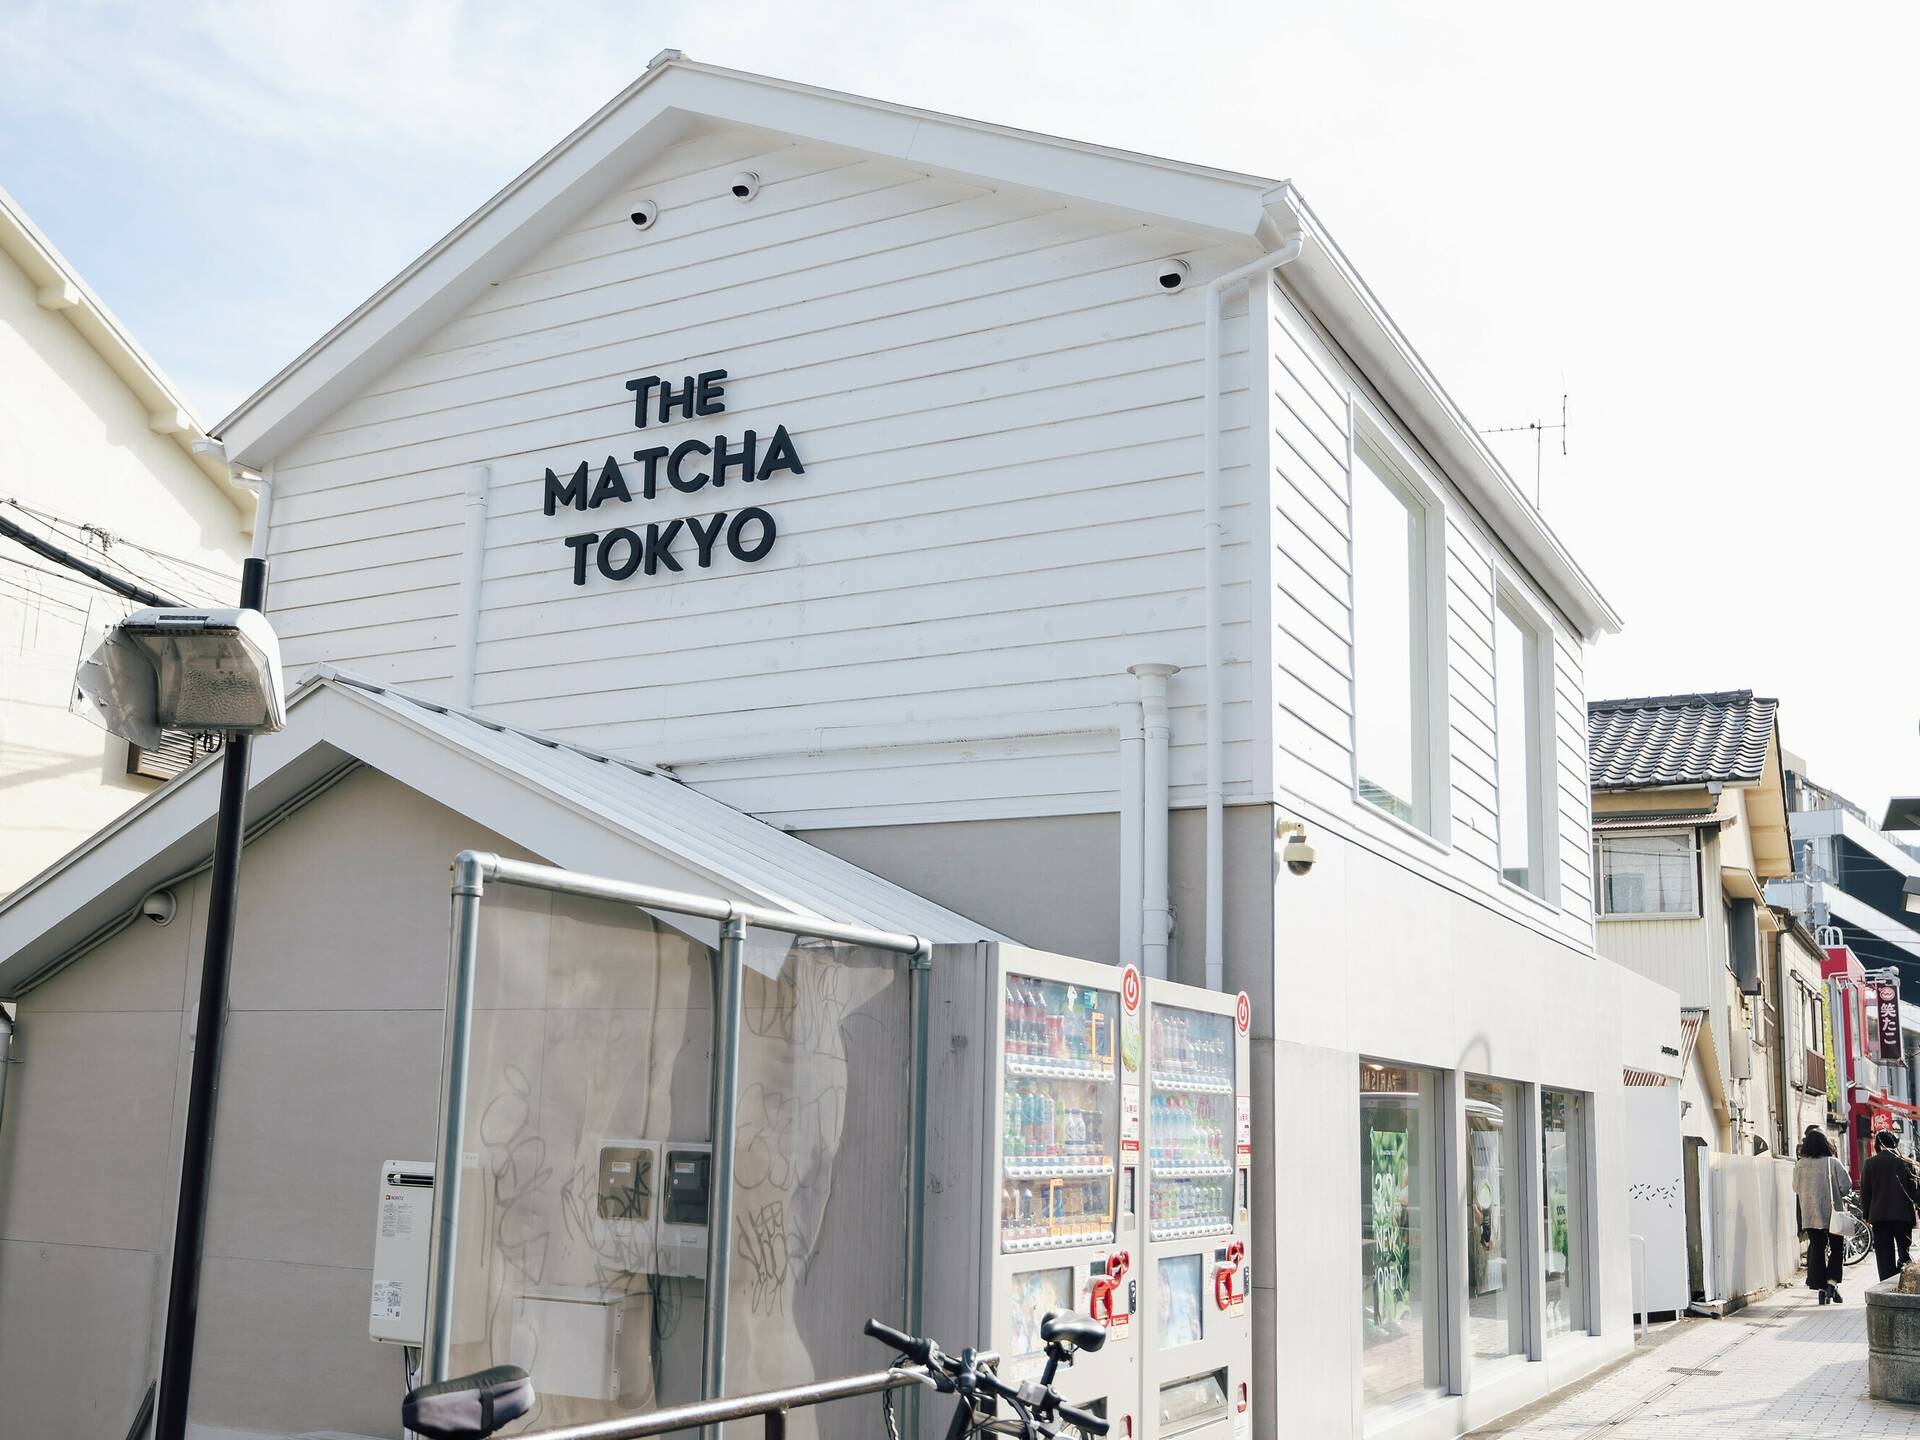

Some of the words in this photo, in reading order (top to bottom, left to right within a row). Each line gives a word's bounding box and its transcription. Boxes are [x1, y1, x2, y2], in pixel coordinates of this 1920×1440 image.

[625, 369, 728, 428] THE
[544, 424, 805, 516] MATCHA
[565, 507, 777, 586] TOKYO
[1880, 1003, 1897, 1045] 笑たこ
[1376, 1227, 1399, 1253] NEW
[1377, 1264, 1403, 1290] OPEN
